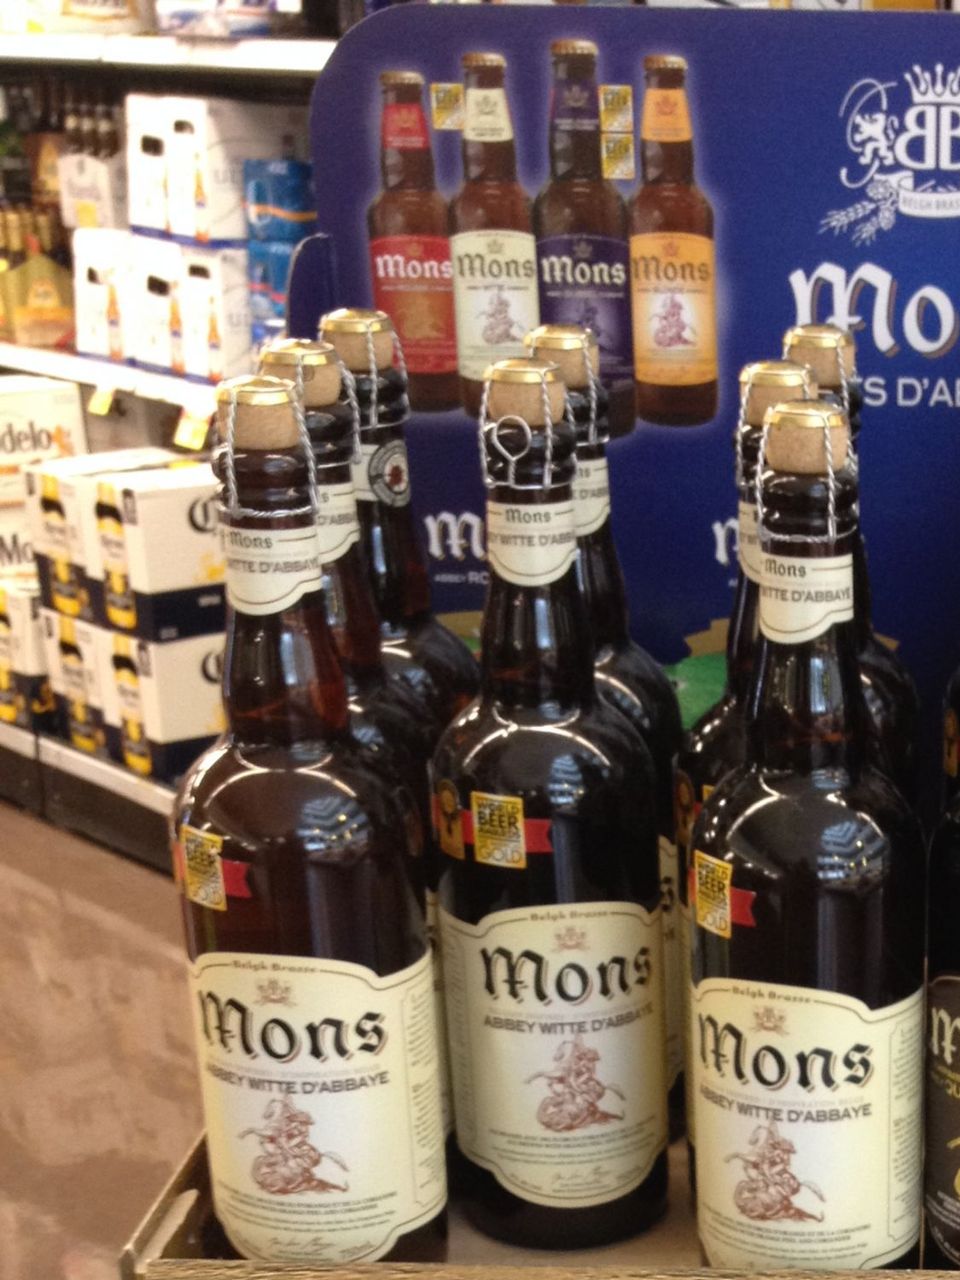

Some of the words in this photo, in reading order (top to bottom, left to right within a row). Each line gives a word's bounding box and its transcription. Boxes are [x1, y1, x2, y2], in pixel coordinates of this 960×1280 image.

[376, 254, 453, 279] Mons
[457, 253, 535, 279] Mons
[541, 255, 627, 285] Mons
[632, 255, 709, 283] Mons
[505, 509, 551, 523] Mons
[229, 530, 273, 548] Mons
[765, 560, 807, 579] Mons
[478, 812, 522, 831] BEER
[699, 871, 727, 894] BEER
[480, 945, 652, 1004] Mons
[199, 989, 389, 1063] Mons
[483, 1015, 536, 1034] ABBEY
[539, 1018, 588, 1035] WITTE
[699, 1011, 875, 1090] Mons
[248, 1074, 301, 1096] WITTE
[302, 1070, 390, 1095] D'ABBAYE
[736, 1101, 781, 1122] WITTE
[787, 1101, 873, 1123] D'ABBAYE
